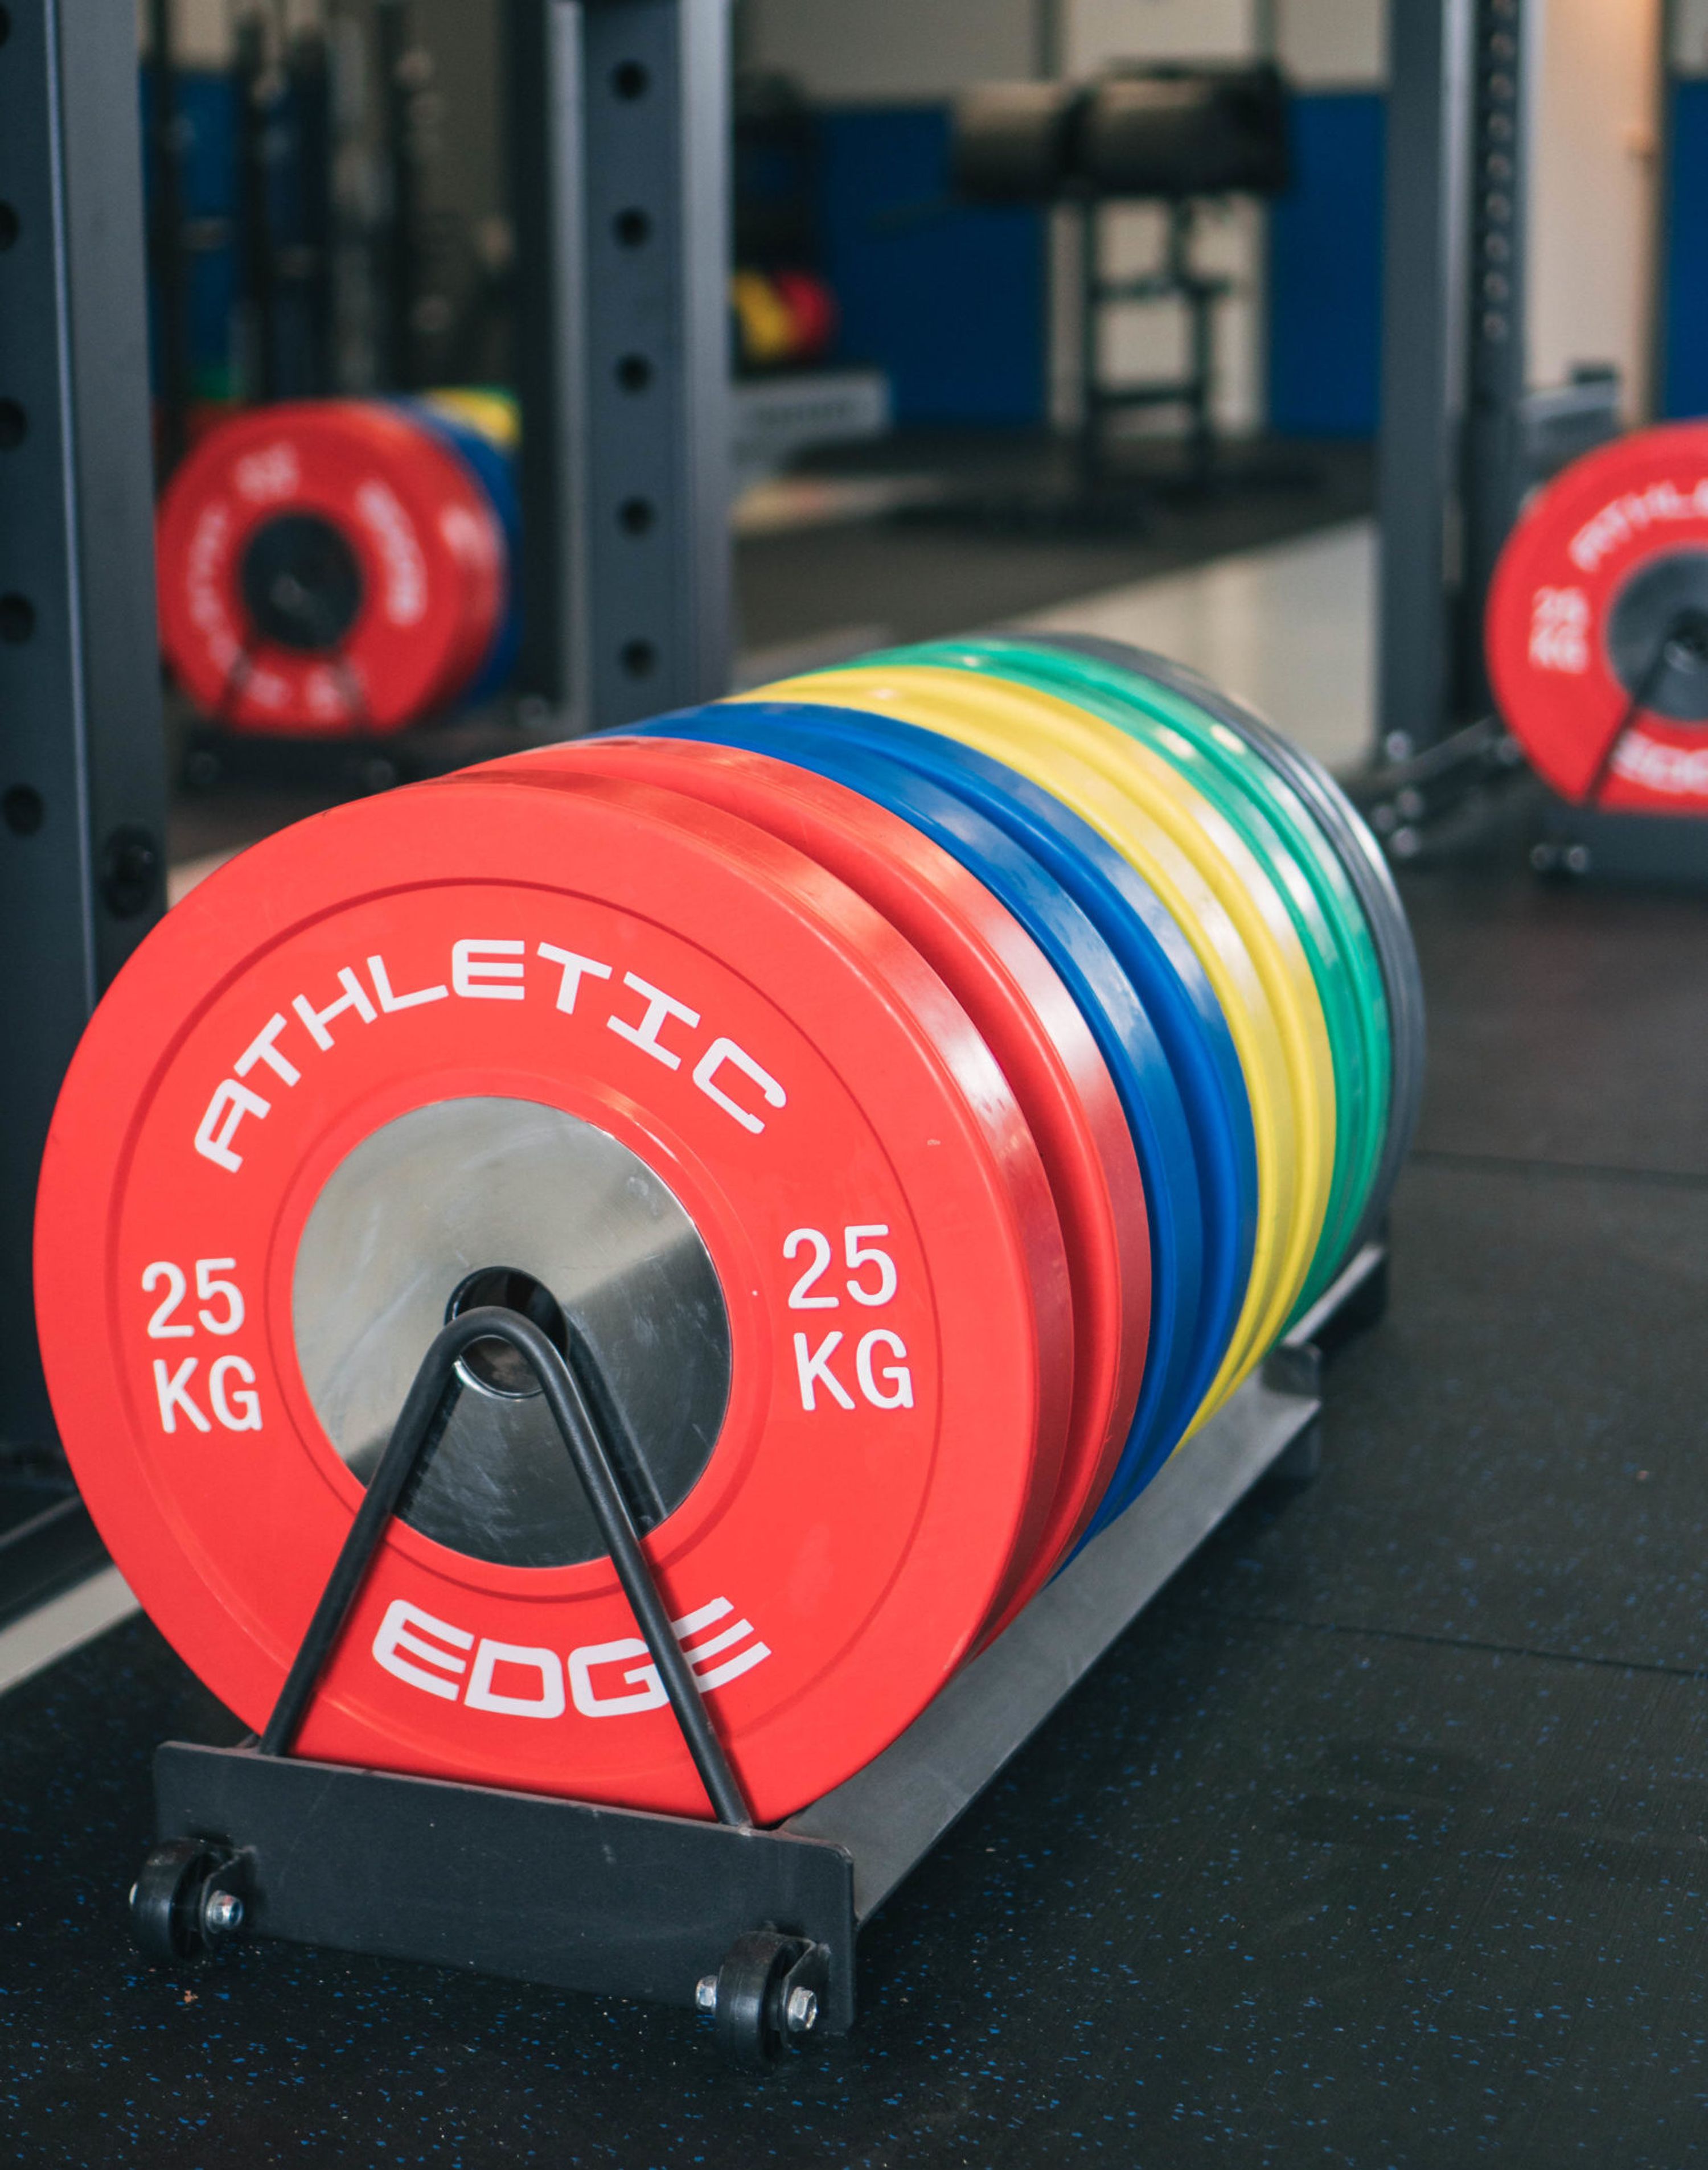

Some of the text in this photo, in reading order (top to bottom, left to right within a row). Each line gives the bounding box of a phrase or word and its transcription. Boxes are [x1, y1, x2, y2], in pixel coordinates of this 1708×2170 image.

[194, 939, 787, 1173] ATHLETIC
[141, 1257, 245, 1339] 25
[782, 1224, 897, 1309] 25
[153, 1355, 263, 1433] KG
[793, 1329, 915, 1411] KG
[372, 1596, 772, 1719] EDGE
